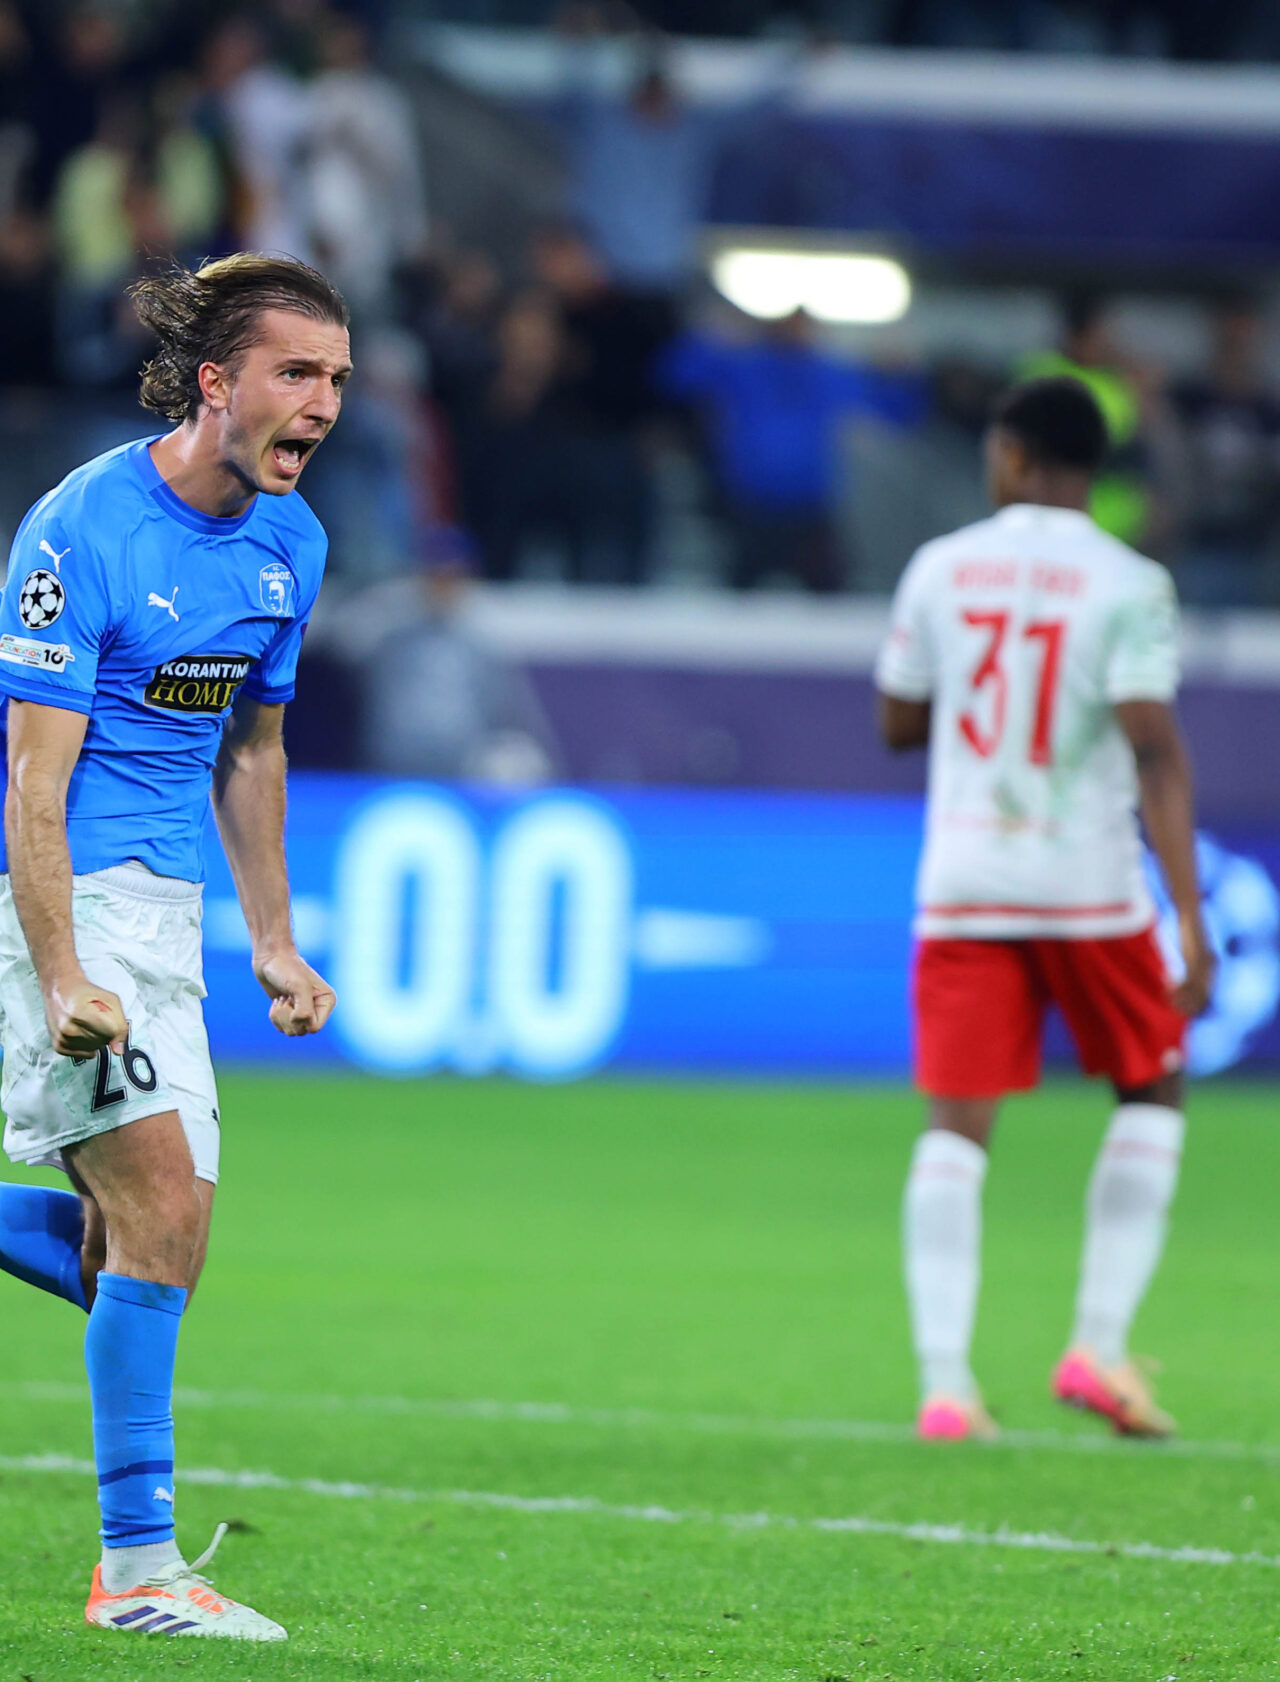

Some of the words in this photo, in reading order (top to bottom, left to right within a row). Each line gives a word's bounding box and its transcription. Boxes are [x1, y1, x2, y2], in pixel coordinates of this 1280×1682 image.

[160, 661, 250, 679] KORANTIN
[957, 607, 1068, 767] 31
[72, 1019, 158, 1113] 26
